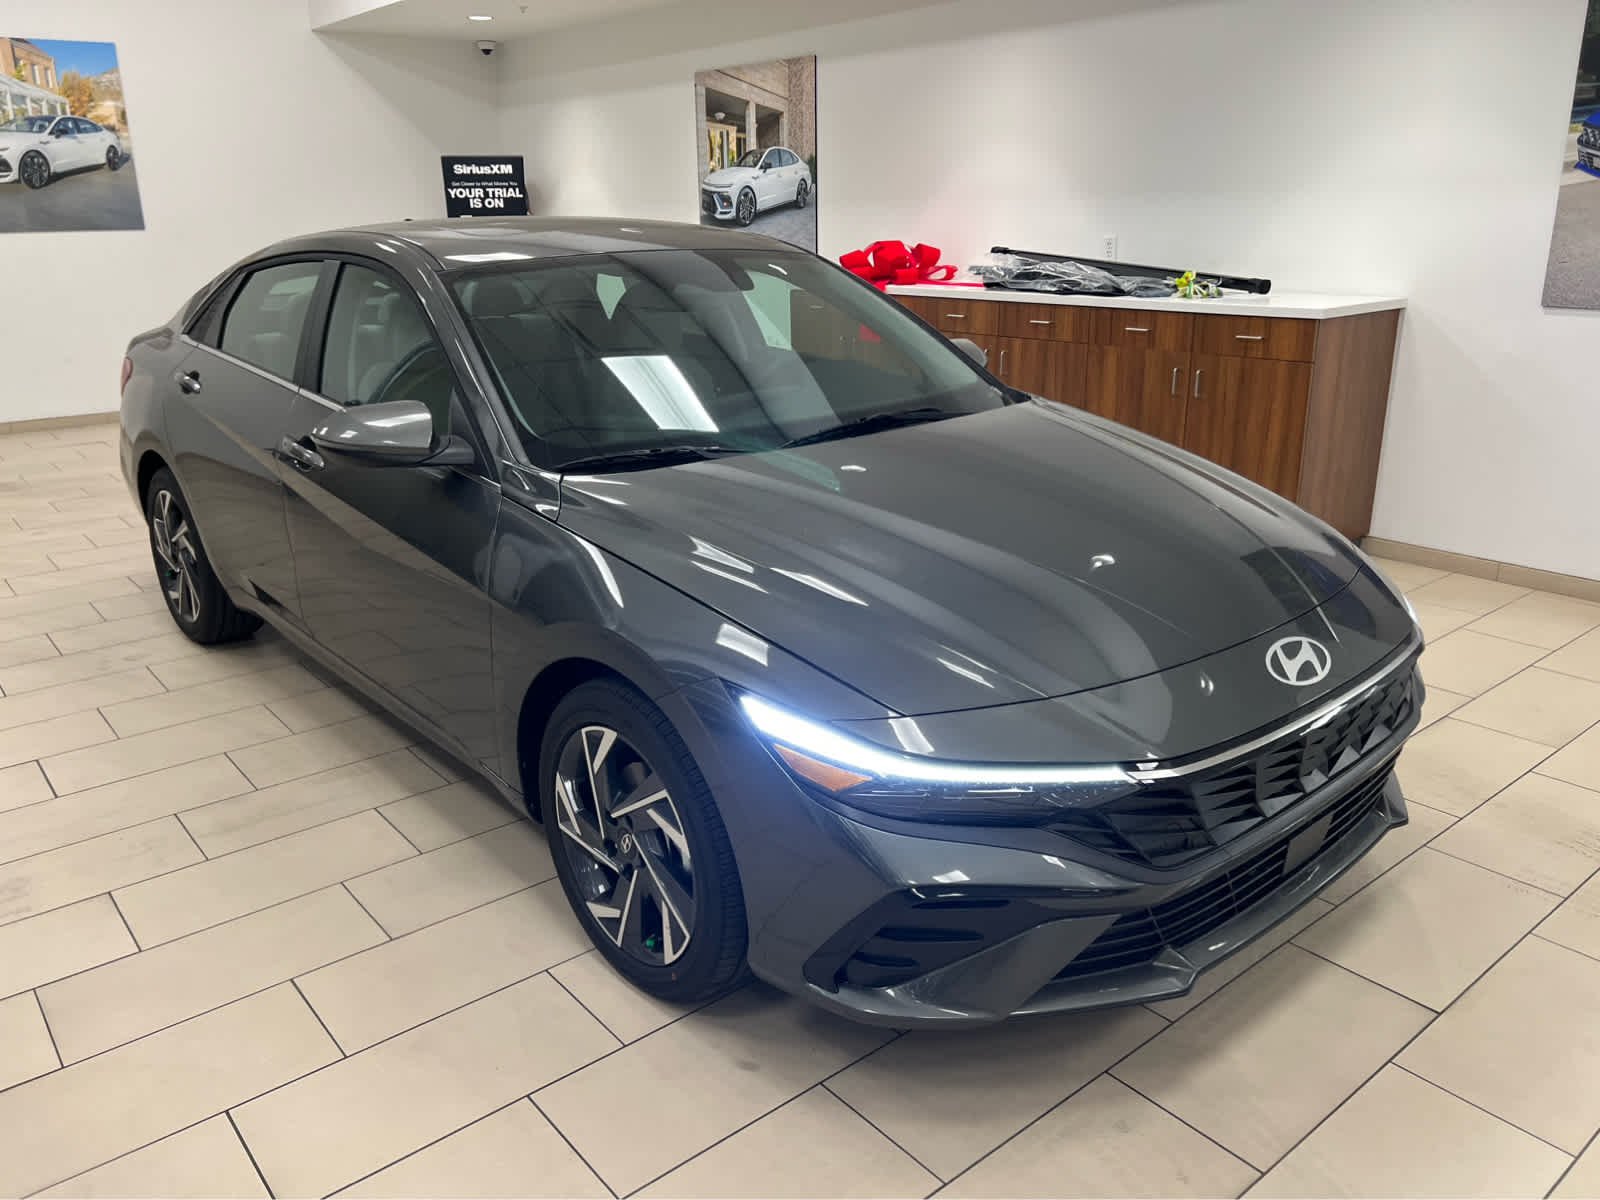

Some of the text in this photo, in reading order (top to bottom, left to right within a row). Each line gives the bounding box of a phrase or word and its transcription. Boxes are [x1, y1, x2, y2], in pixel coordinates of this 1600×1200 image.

[453, 164, 513, 174] SiriusXM
[448, 187, 523, 198] YOUR TRIAL
[469, 198, 504, 208] IS ON
